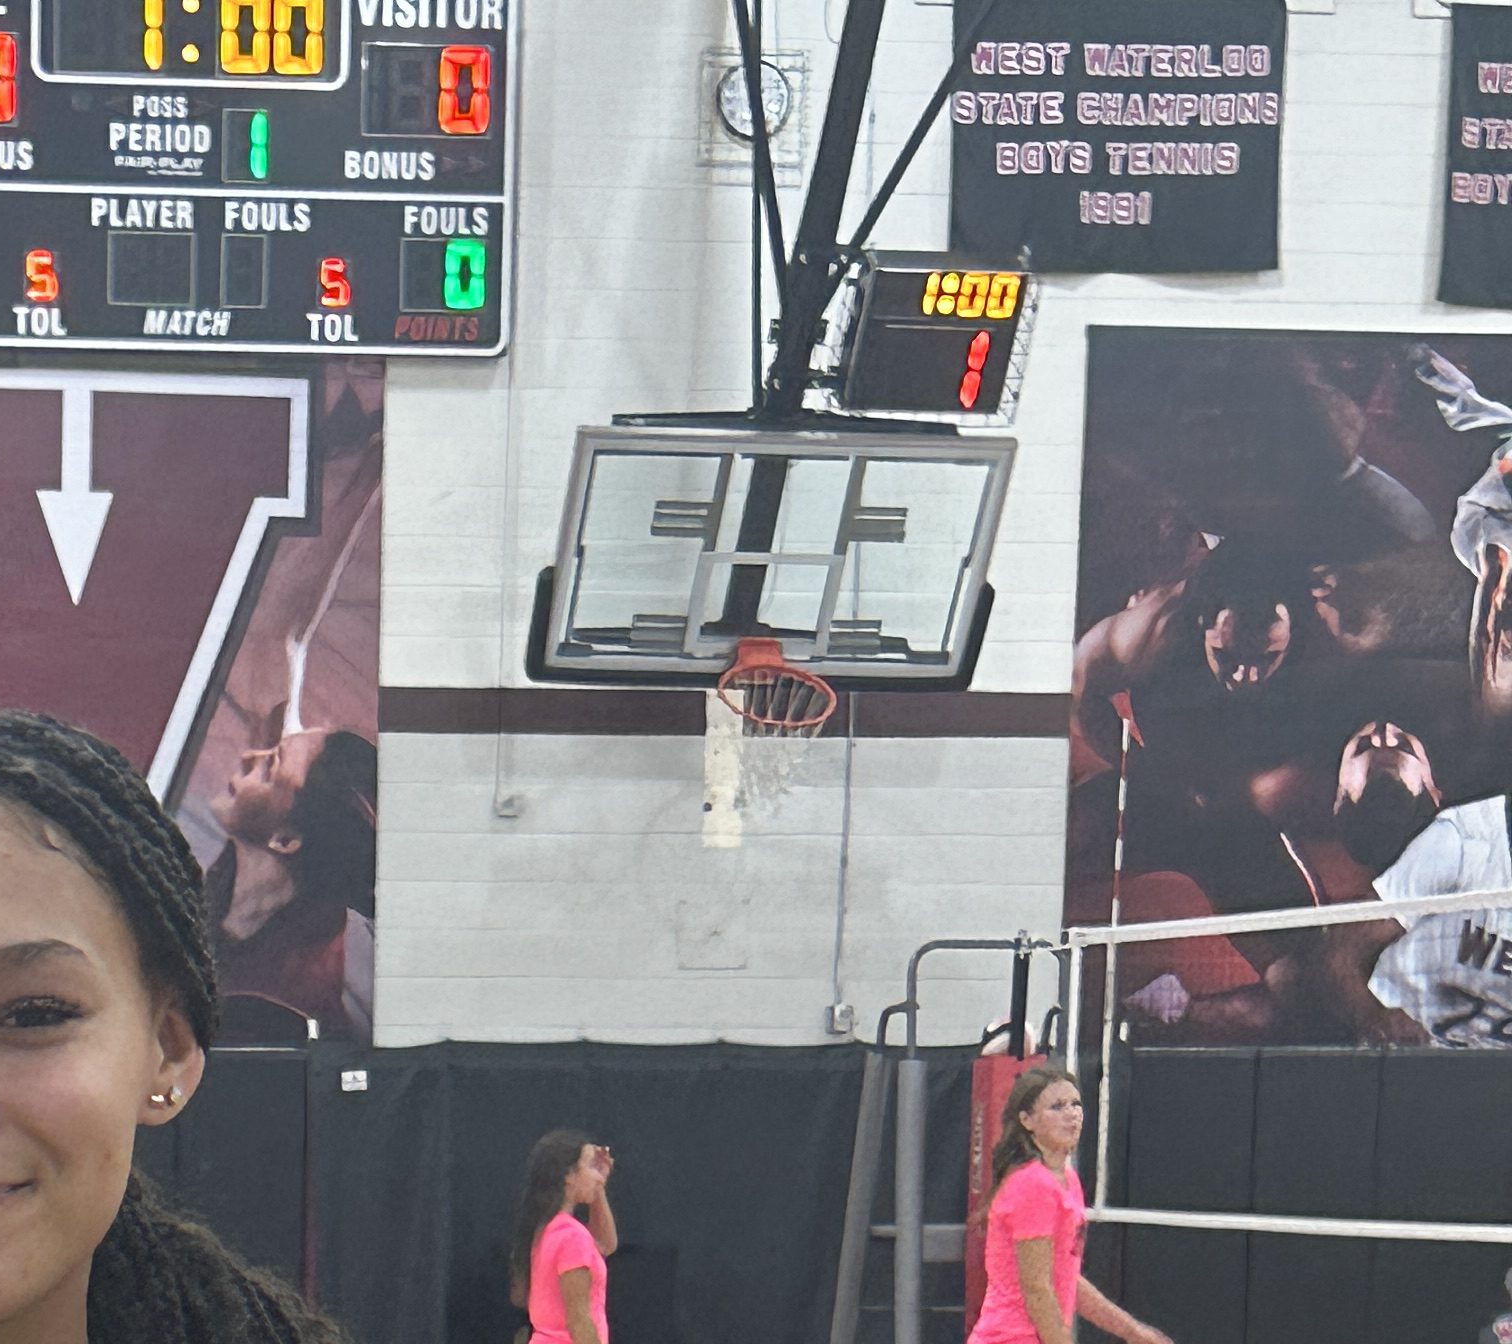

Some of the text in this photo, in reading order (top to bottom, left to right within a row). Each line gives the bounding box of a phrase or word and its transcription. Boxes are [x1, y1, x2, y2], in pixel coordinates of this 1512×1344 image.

[358, 0, 504, 30] VISITOR
[971, 42, 1271, 77] WEST WATERLOO
[132, 95, 188, 118] POSS
[438, 46, 491, 135] 0
[952, 92, 1279, 126] STATE CHAMPIONS
[109, 122, 211, 153] PERIOD
[249, 109, 269, 180] 1
[344, 150, 436, 181] BONUS
[996, 141, 1240, 175] BOYS TENNIS
[91, 198, 311, 232] PLAYER FOULS
[404, 205, 488, 235] FOULS
[1080, 191, 1152, 225] 1991
[24, 249, 59, 302] 5
[320, 257, 351, 308] 5
[444, 239, 486, 310] 0
[922, 272, 1021, 319] 1:00
[12, 307, 67, 336] TOL
[143, 309, 231, 336] MATCH
[305, 314, 359, 342] TOL
[394, 316, 478, 341] POINTS
[959, 331, 990, 410] 1
